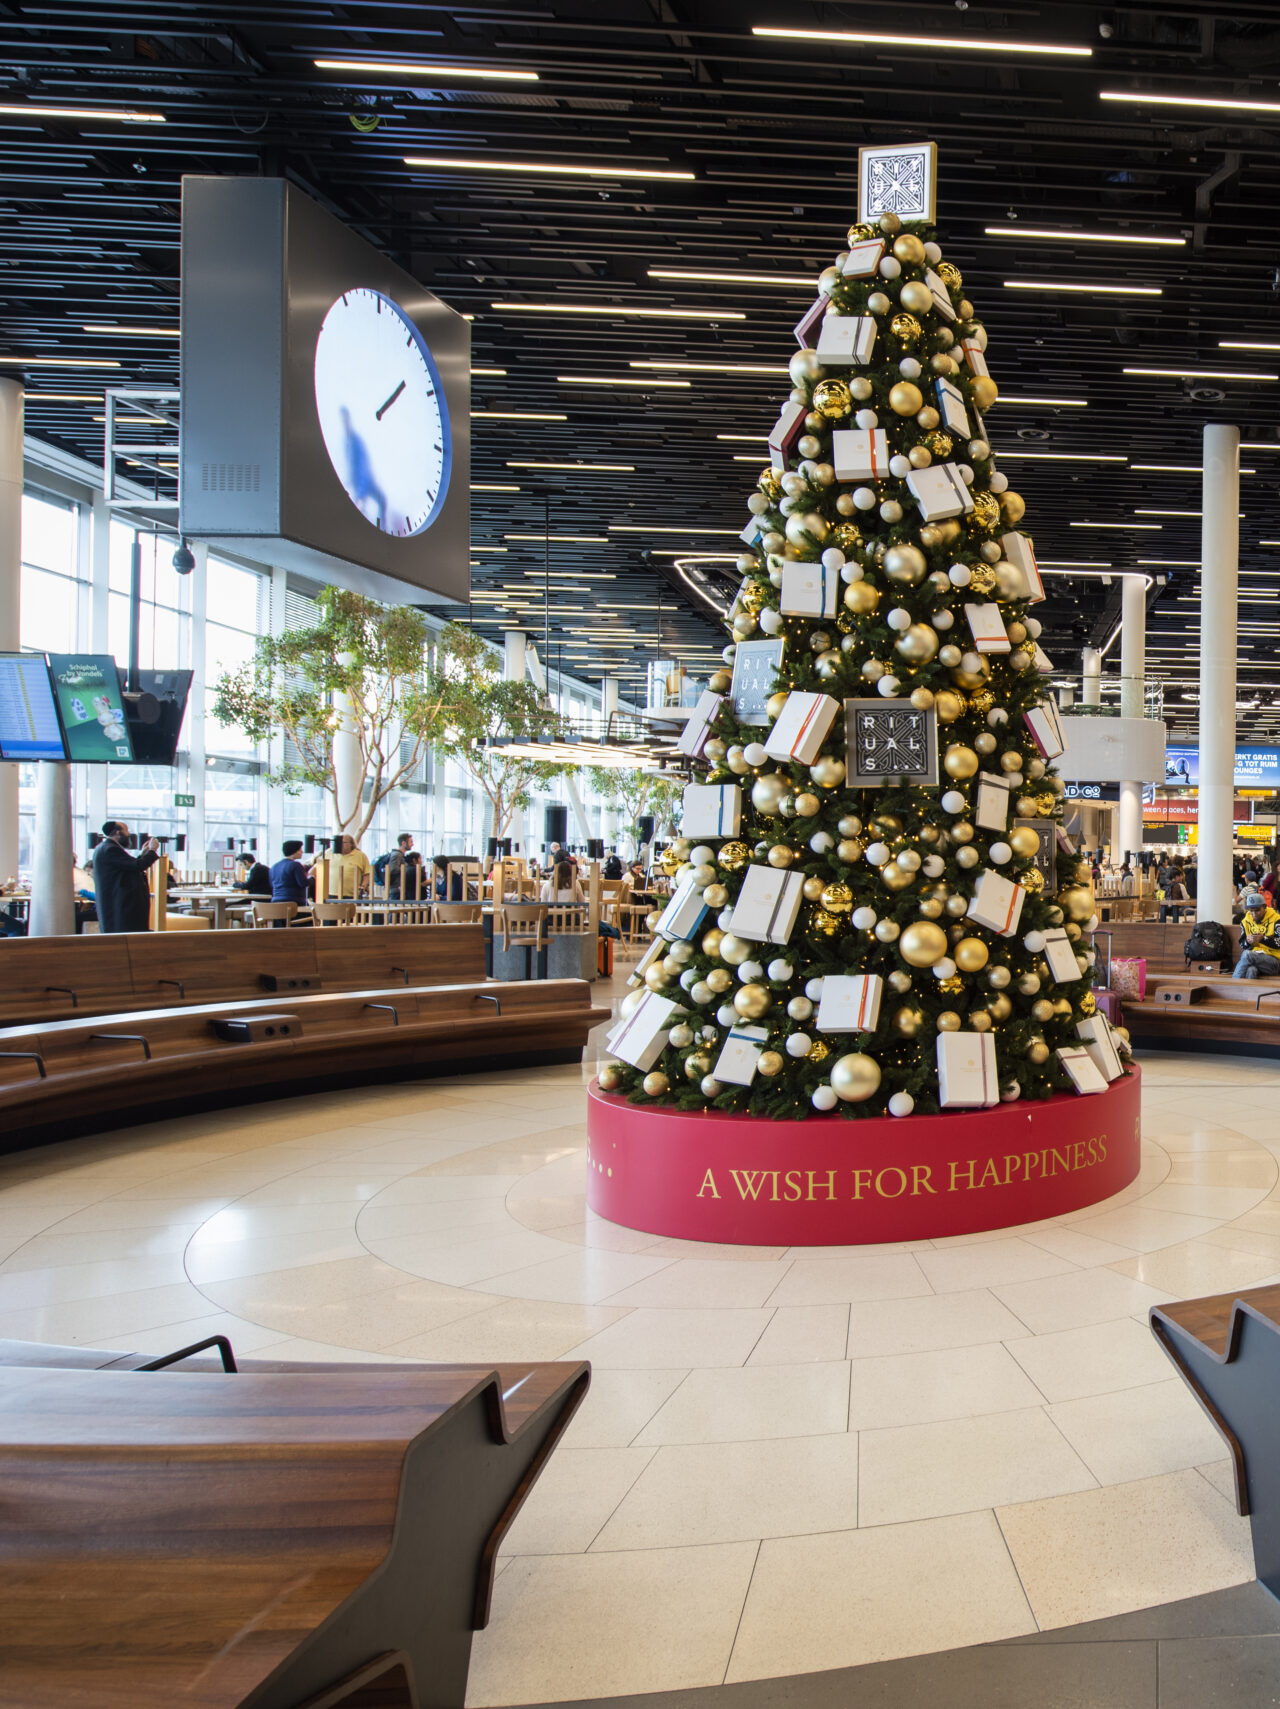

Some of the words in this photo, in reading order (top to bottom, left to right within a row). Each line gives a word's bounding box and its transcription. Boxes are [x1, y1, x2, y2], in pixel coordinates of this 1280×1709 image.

[696, 1168, 721, 1199] A
[729, 1170, 837, 1201] WISH
[851, 1166, 938, 1200] FOR
[947, 1134, 1108, 1192] HAPPINESS
